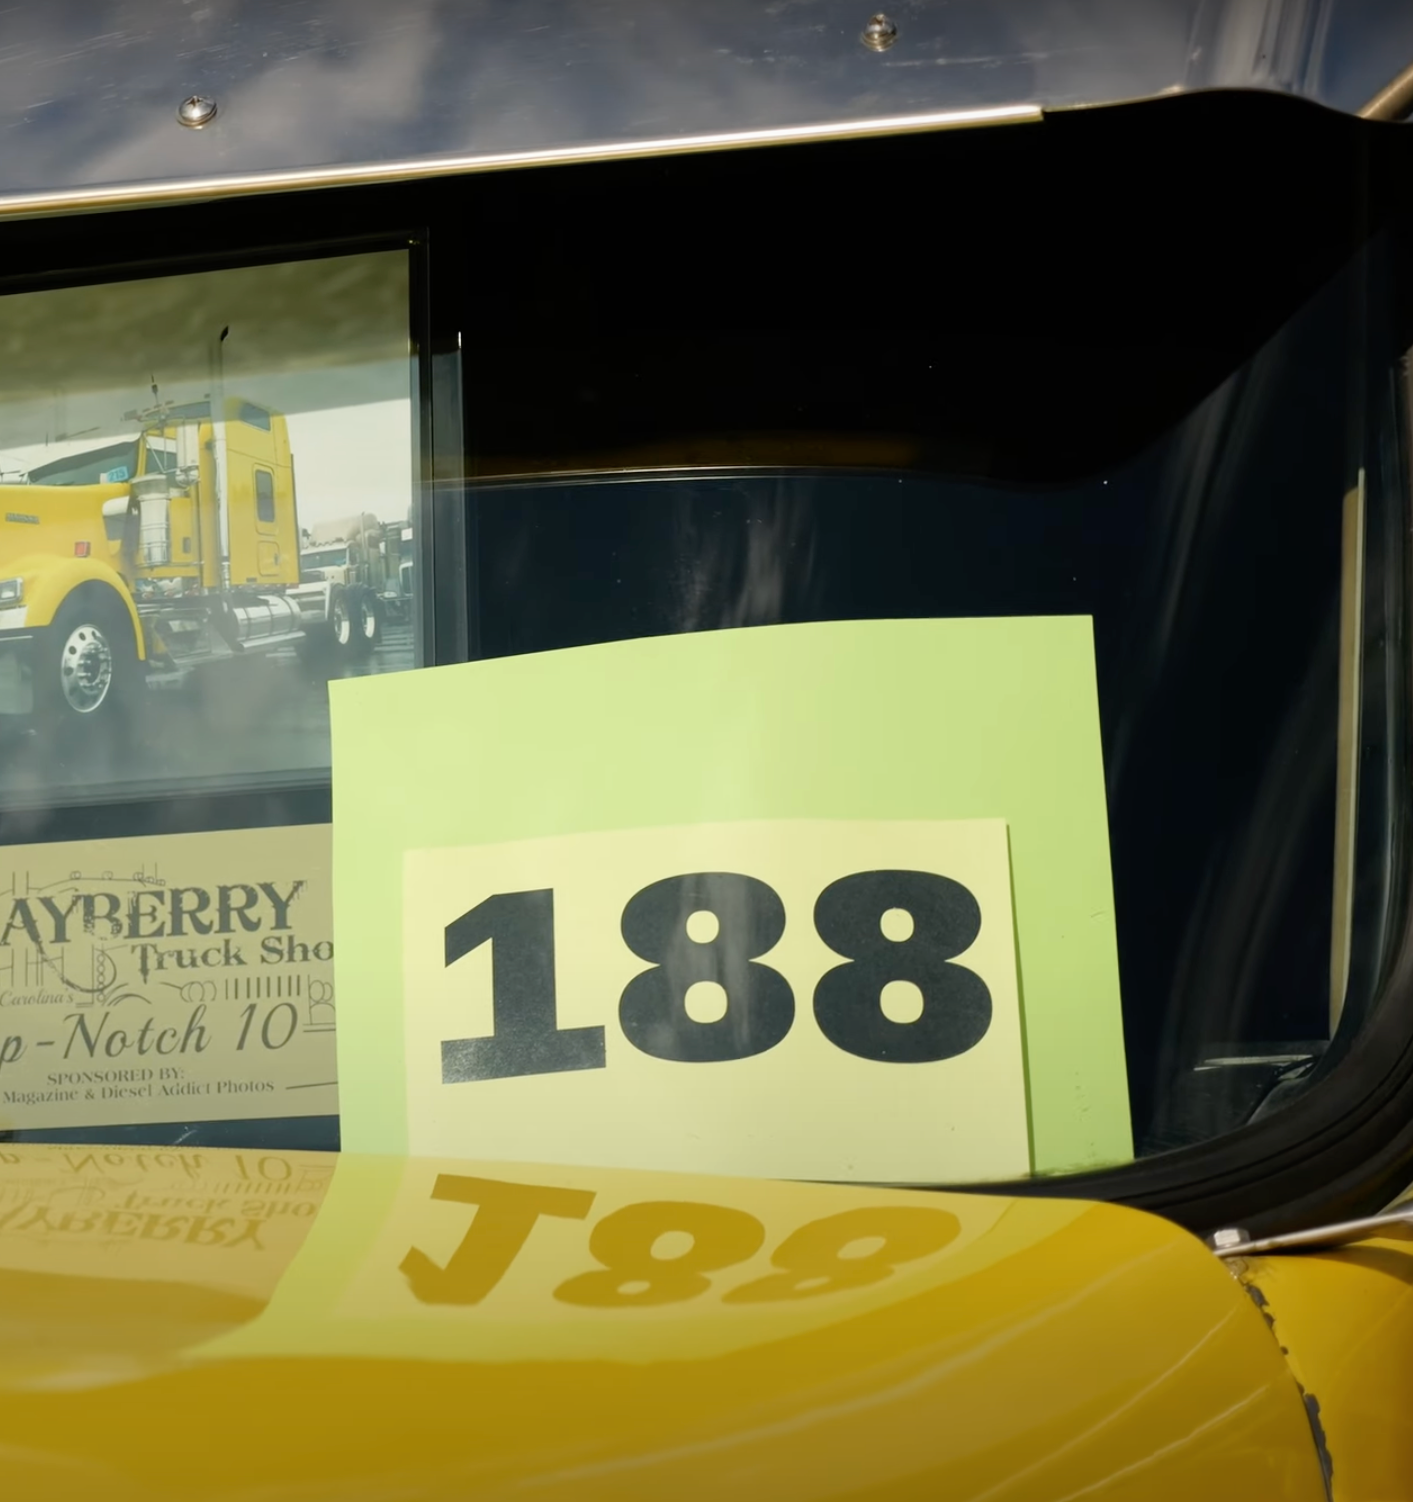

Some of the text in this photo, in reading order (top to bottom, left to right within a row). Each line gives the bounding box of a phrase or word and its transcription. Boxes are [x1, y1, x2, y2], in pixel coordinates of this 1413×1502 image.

[131, 934, 334, 984] Truck Sho
[441, 869, 993, 1084] 188
[0, 987, 74, 1008] Carolina's
[236, 1002, 298, 1051] 10
[2, 1087, 79, 1107] Magazine
[85, 1087, 95, 1100] &
[101, 1083, 152, 1099] Diesel
[158, 1081, 211, 1097] Addict
[217, 1079, 275, 1095] Photos
[47, 1066, 185, 1086] SPONSORED BY:
